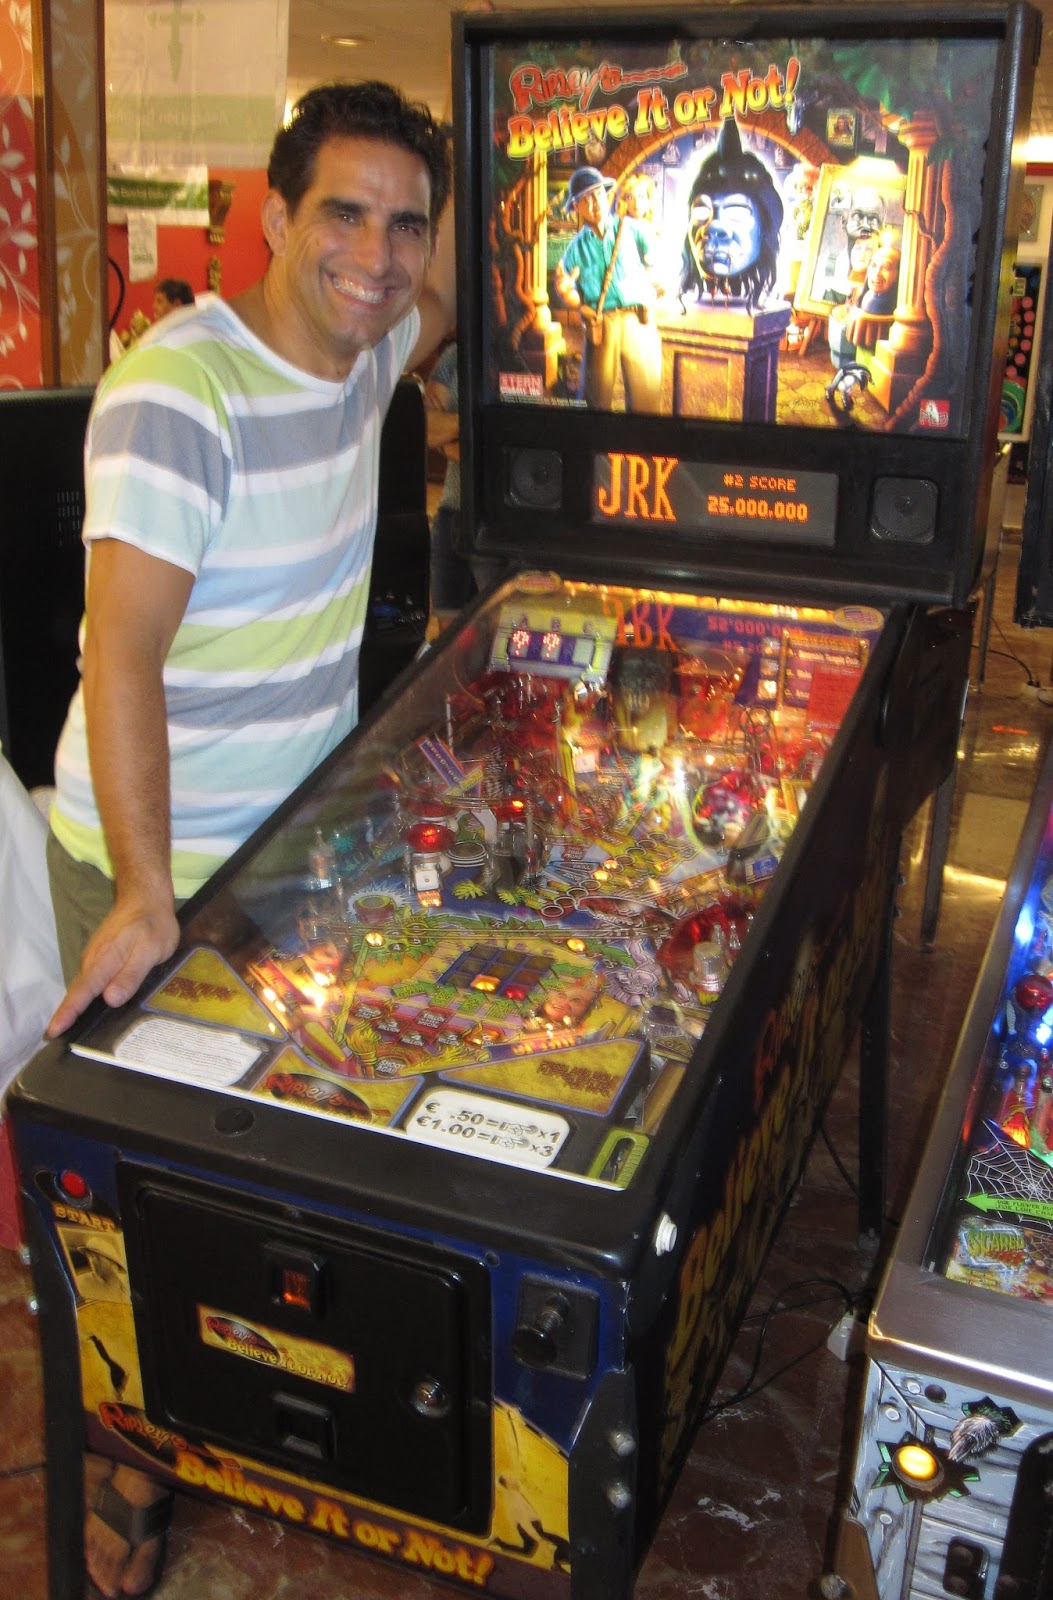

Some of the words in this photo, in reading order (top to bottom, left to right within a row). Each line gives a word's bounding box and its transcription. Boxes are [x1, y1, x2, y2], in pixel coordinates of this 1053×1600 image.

[508, 104, 630, 159] Believe
[634, 87, 669, 135] It
[674, 86, 717, 126] or
[719, 57, 800, 120] Not!
[598, 452, 679, 523] JRK
[723, 473, 744, 489] #2
[749, 475, 796, 493] SCORE
[707, 494, 809, 523] 25.000.000
[379, 1059, 406, 1069] SHOOT
[53, 1203, 117, 1231] START
[227, 1337, 278, 1365] Believe
[279, 1347, 297, 1371] It
[300, 1364, 314, 1377] or
[316, 1366, 350, 1388] Not!
[174, 1449, 305, 1522] Believe
[309, 1498, 349, 1539] It
[351, 1519, 400, 1553] or
[403, 1530, 494, 1587] Not!
